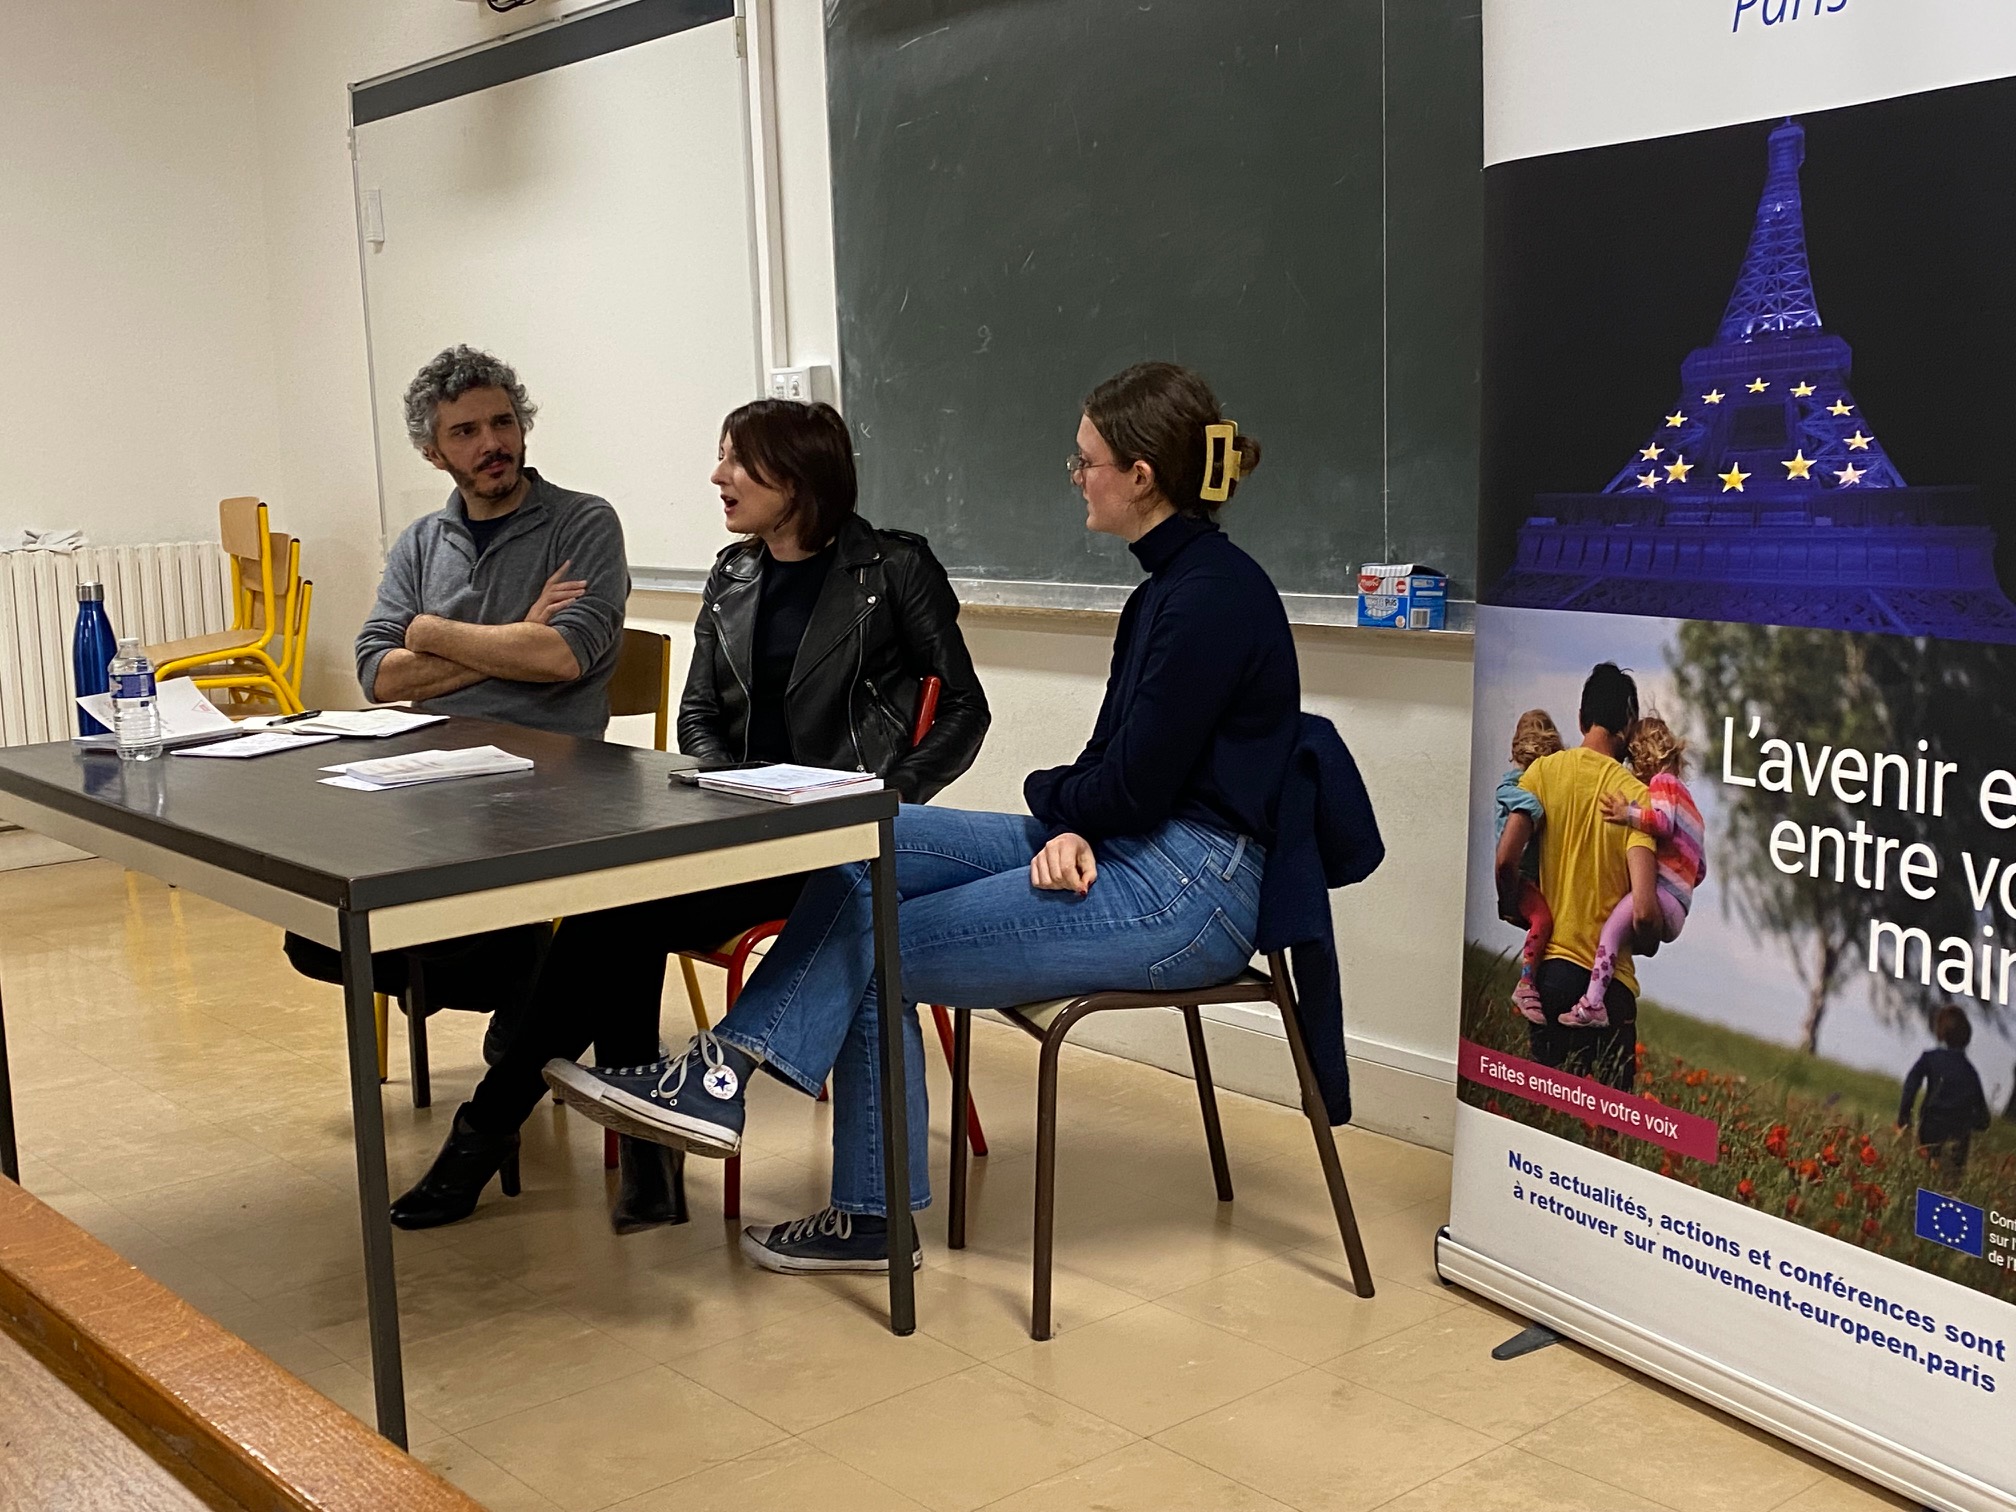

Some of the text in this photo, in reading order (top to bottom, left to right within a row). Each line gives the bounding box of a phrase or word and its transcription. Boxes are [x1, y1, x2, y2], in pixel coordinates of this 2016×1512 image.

[1722, 716, 1958, 817] L'avenir
[1769, 820, 1938, 900] entre
[1480, 1056, 1679, 1140] Faites entendre votre voix
[1509, 1150, 2006, 1362] Nos actualités, actions et conférences sont
[1988, 1250, 2004, 1266] de
[1989, 1211, 2016, 1232] Con
[1989, 1232, 2009, 1248] sur
[1513, 1180, 1996, 1393] à retrouver sur mouvement-europeen.paris
